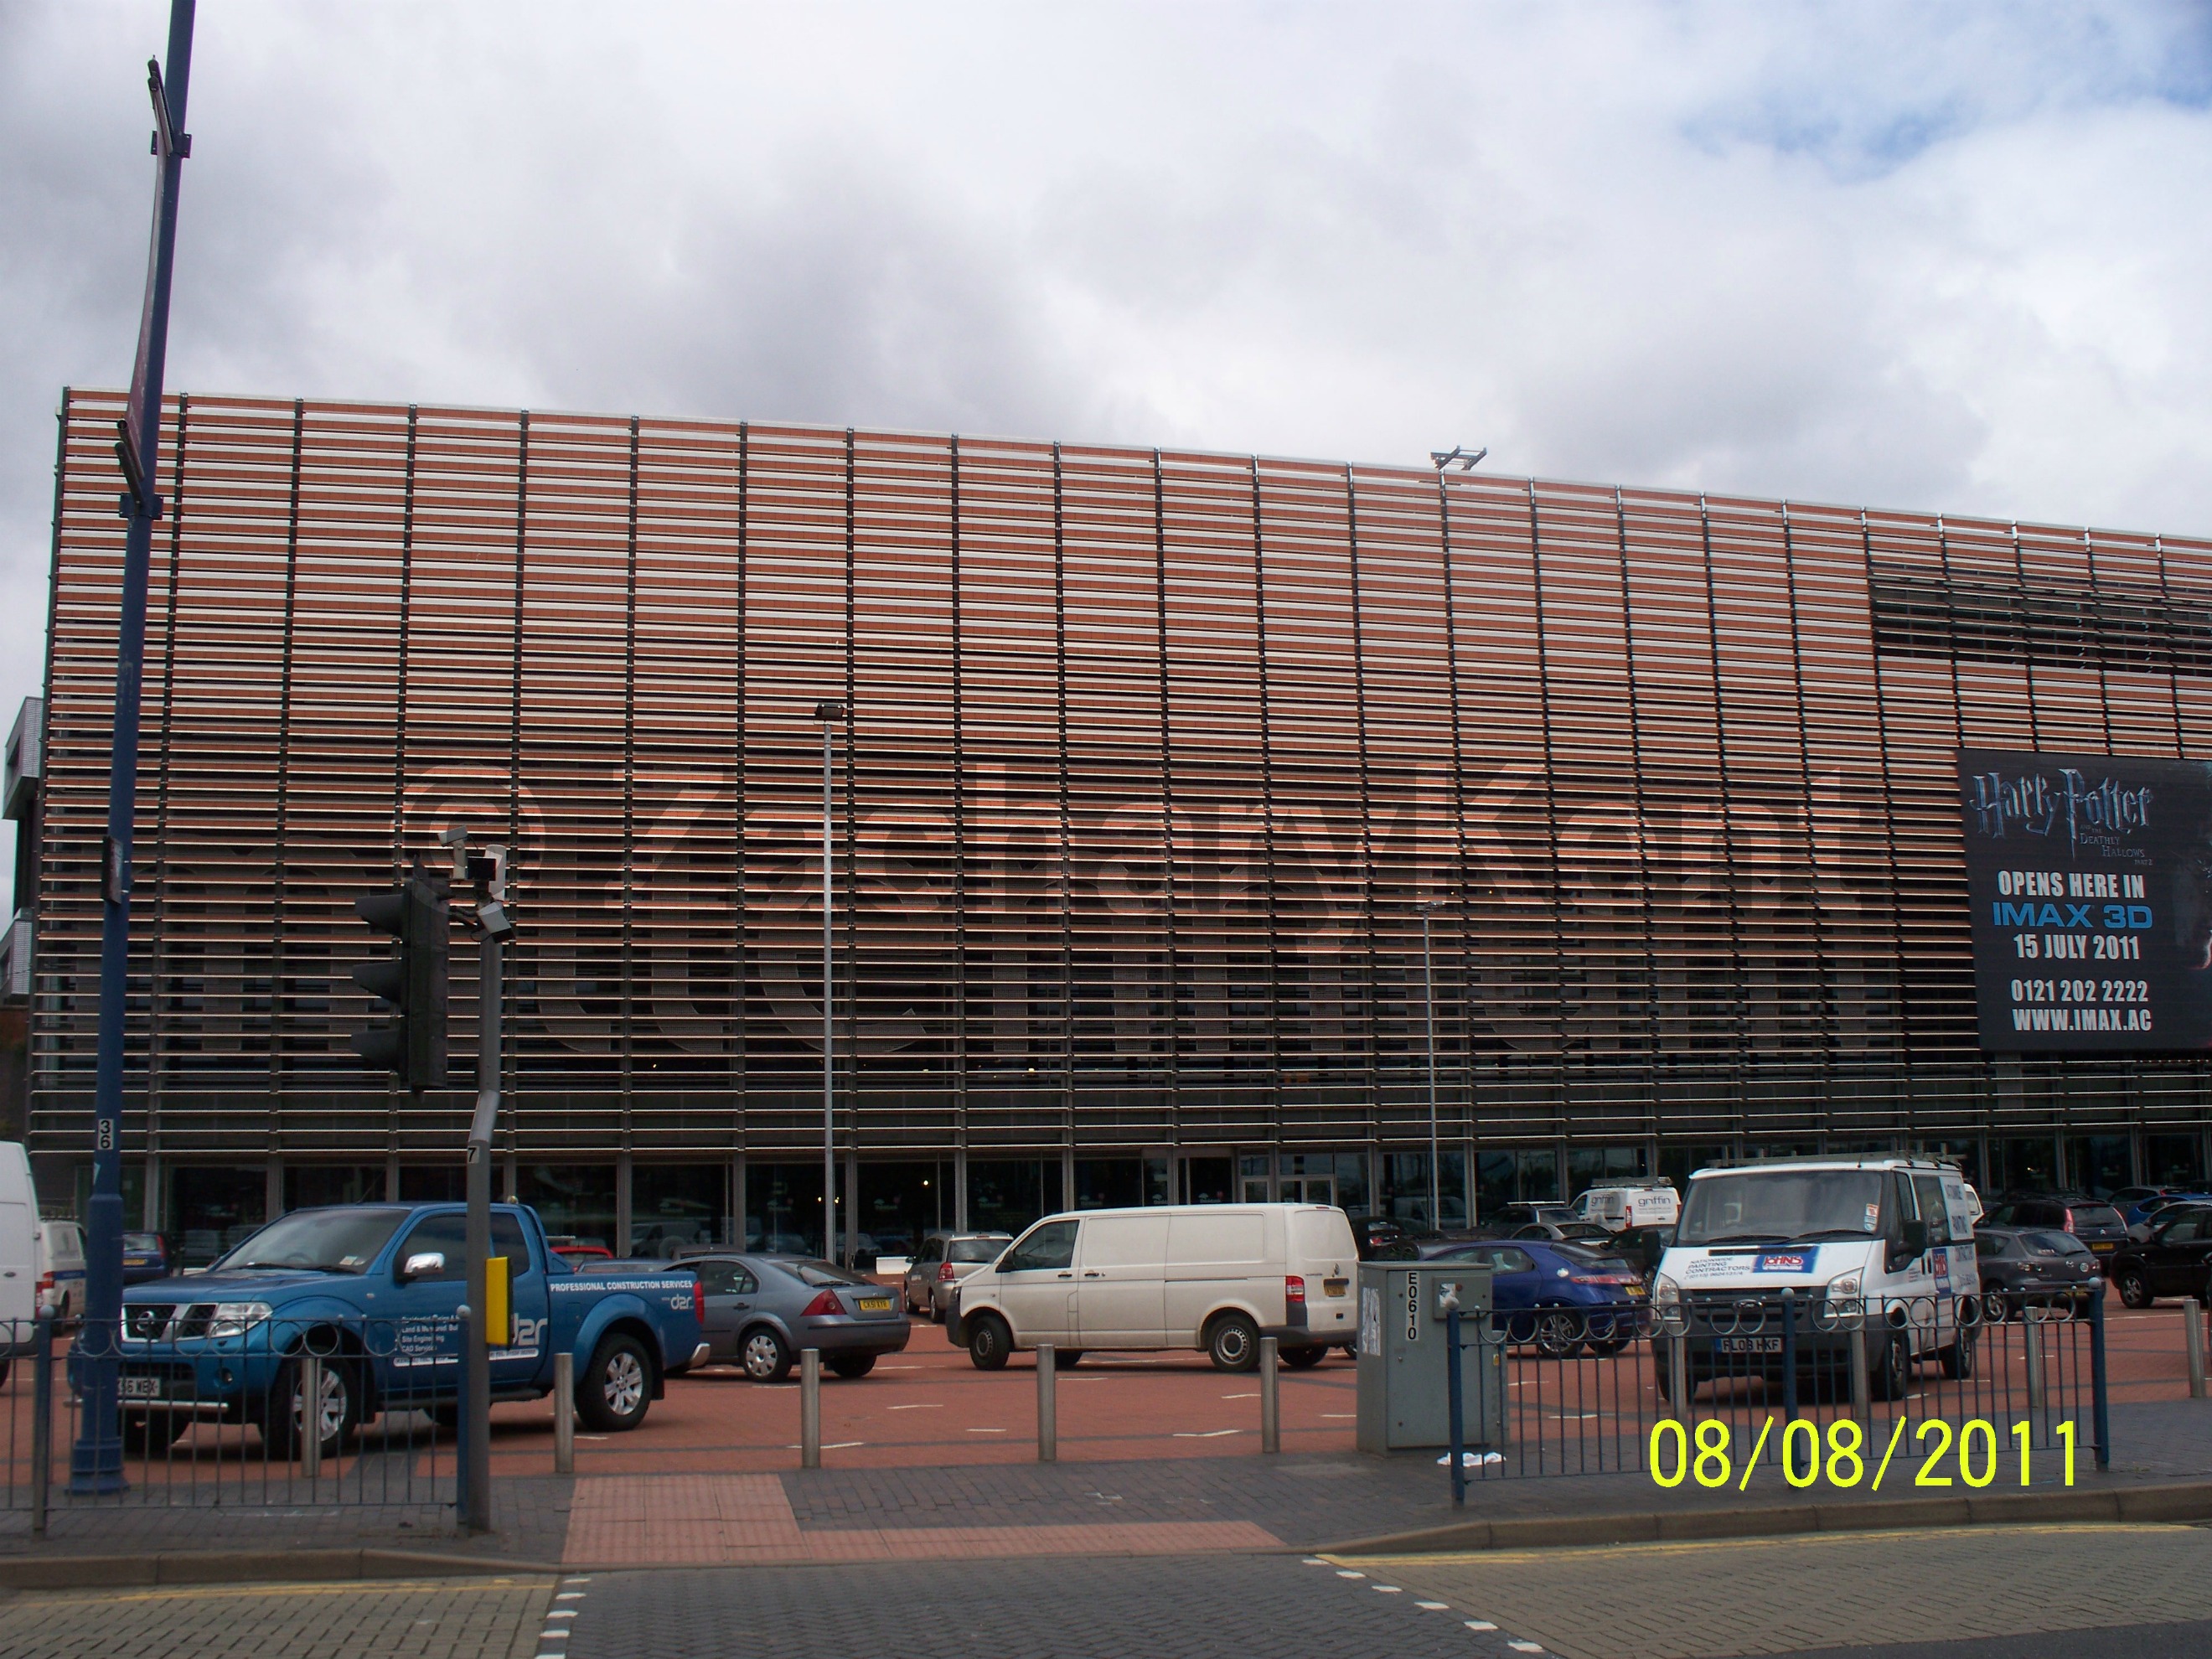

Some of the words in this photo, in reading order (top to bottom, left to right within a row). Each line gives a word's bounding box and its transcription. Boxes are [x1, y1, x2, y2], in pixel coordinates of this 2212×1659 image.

[1970, 773, 2060, 838] Harry
[2059, 769, 2154, 861] Potter
[2080, 833, 2120, 845] DEATHLY
[2101, 845, 2145, 857] HALLOWS
[1998, 871, 2064, 897] OPENS
[2069, 873, 2119, 898] HERE
[2123, 875, 2145, 899] IN
[1992, 902, 2094, 928] IMAX
[2103, 904, 2153, 928] 3D
[2013, 933, 2037, 959] 15
[2044, 934, 2087, 959] JULY
[2093, 935, 2140, 960] 2011
[2011, 979, 2054, 1002] 0121
[2060, 979, 2096, 1002] 202
[2101, 980, 2149, 1002] 2222
[2012, 1008, 2153, 1031] WWW.IMAX.AC
[468, 1147, 477, 1162] 7
[1638, 1196, 1671, 1207] griffin
[1685, 1265, 1750, 1274] CONTRACTORS
[1687, 1261, 1727, 1269] PAINTING
[550, 1282, 605, 1291] PROFESSIONAL
[607, 1281, 660, 1290] CONSTRUCTION
[661, 1279, 693, 1289] SERVICES
[1408, 1272, 1418, 1340] E0610
